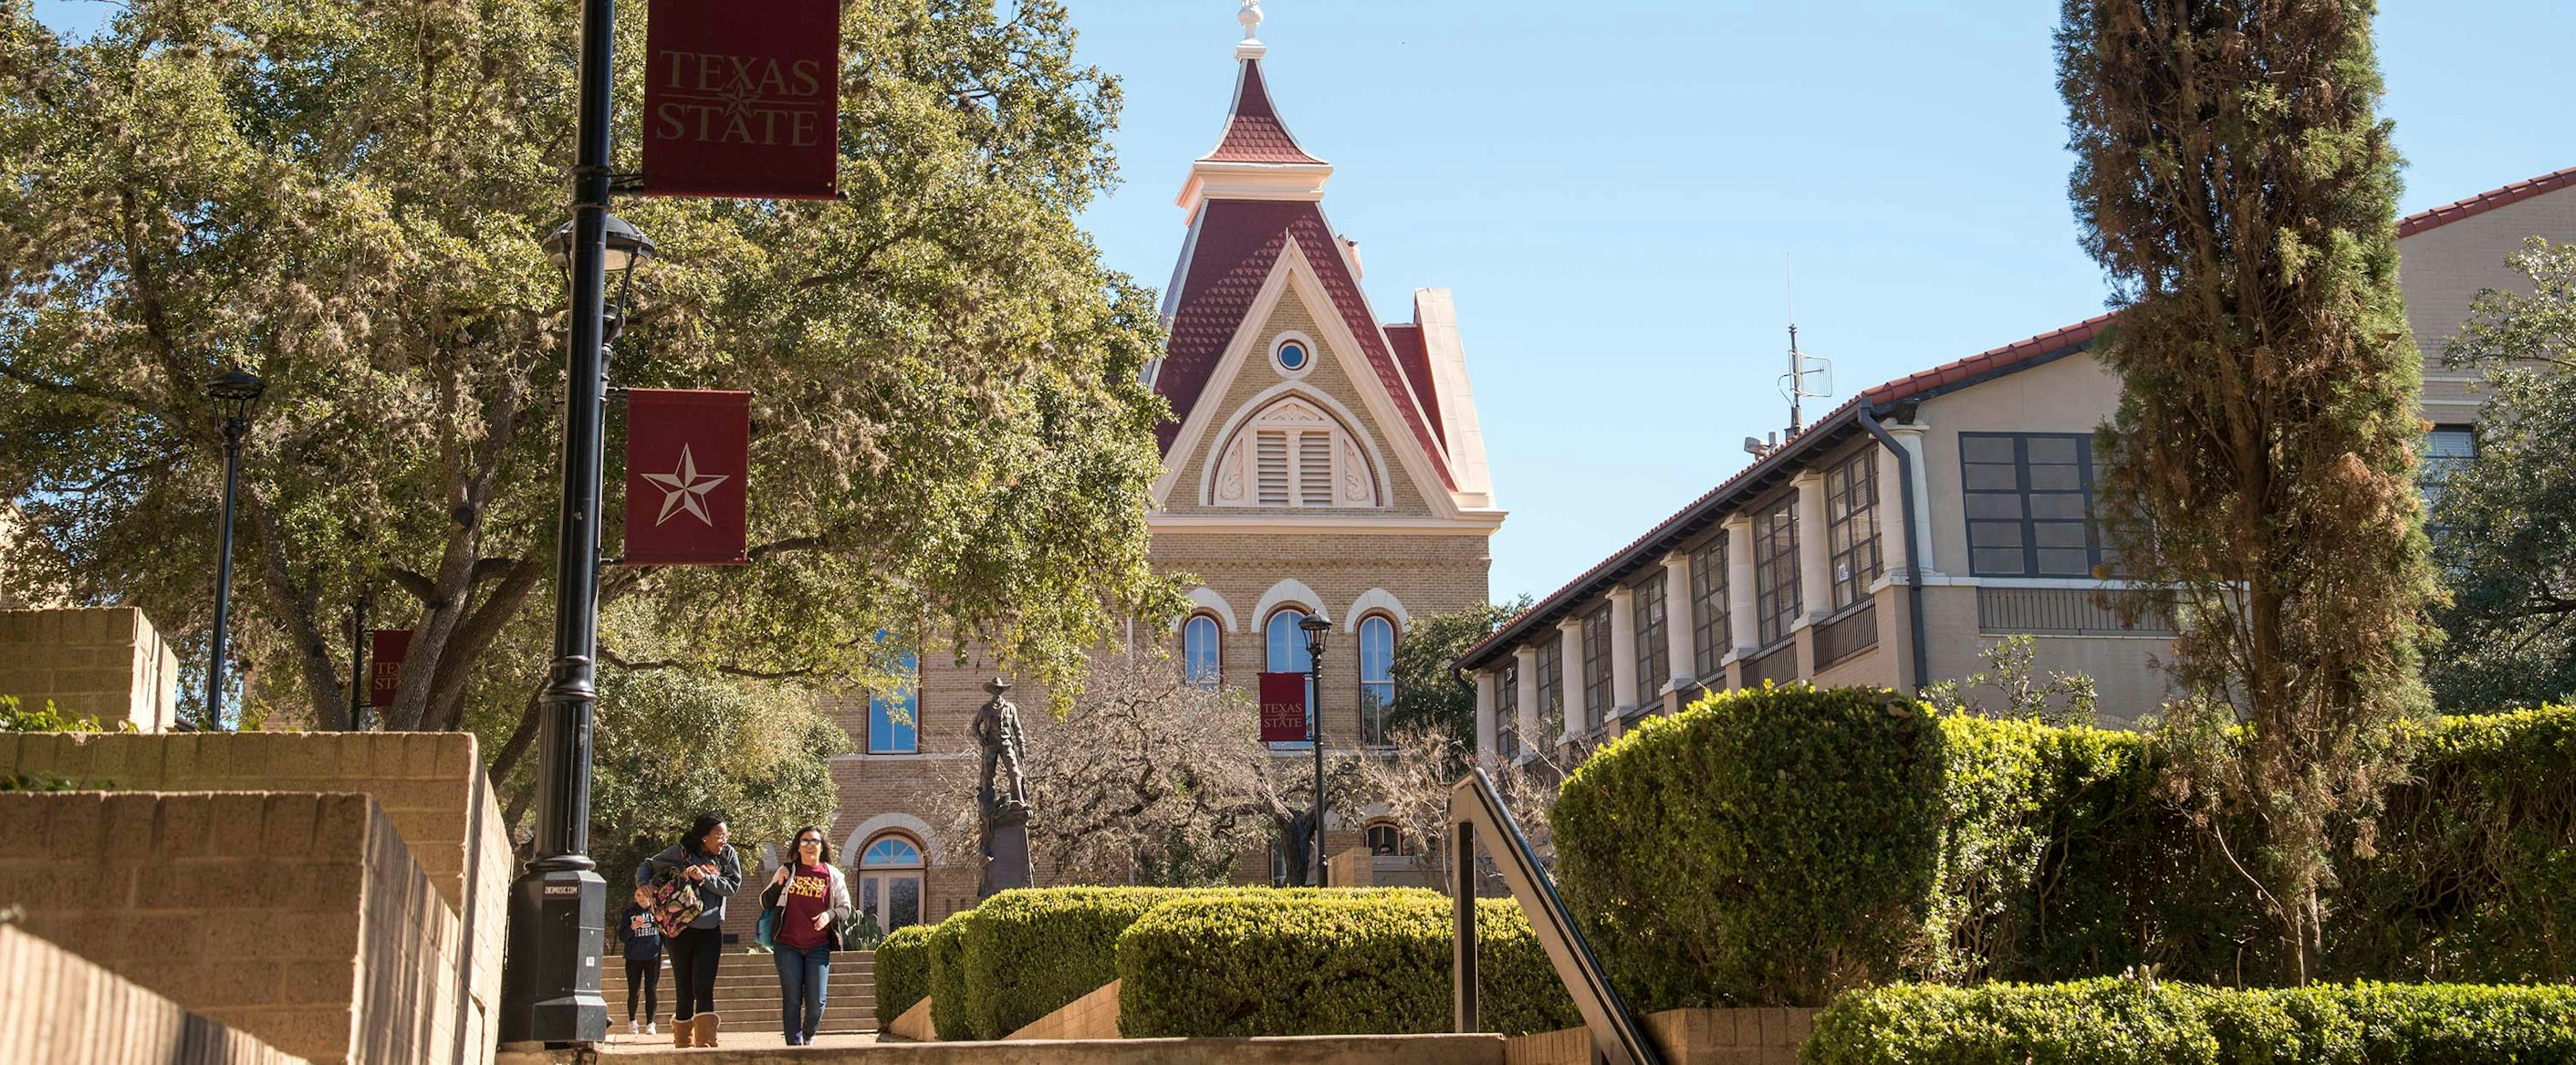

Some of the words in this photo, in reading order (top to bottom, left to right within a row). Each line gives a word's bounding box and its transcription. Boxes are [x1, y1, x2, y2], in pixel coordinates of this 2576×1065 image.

[660, 49, 819, 97] TEXAS
[656, 102, 819, 146] STATE
[1263, 703, 1302, 714] TEXAS
[1264, 717, 1302, 728] STATE
[788, 884, 823, 899] STATE
